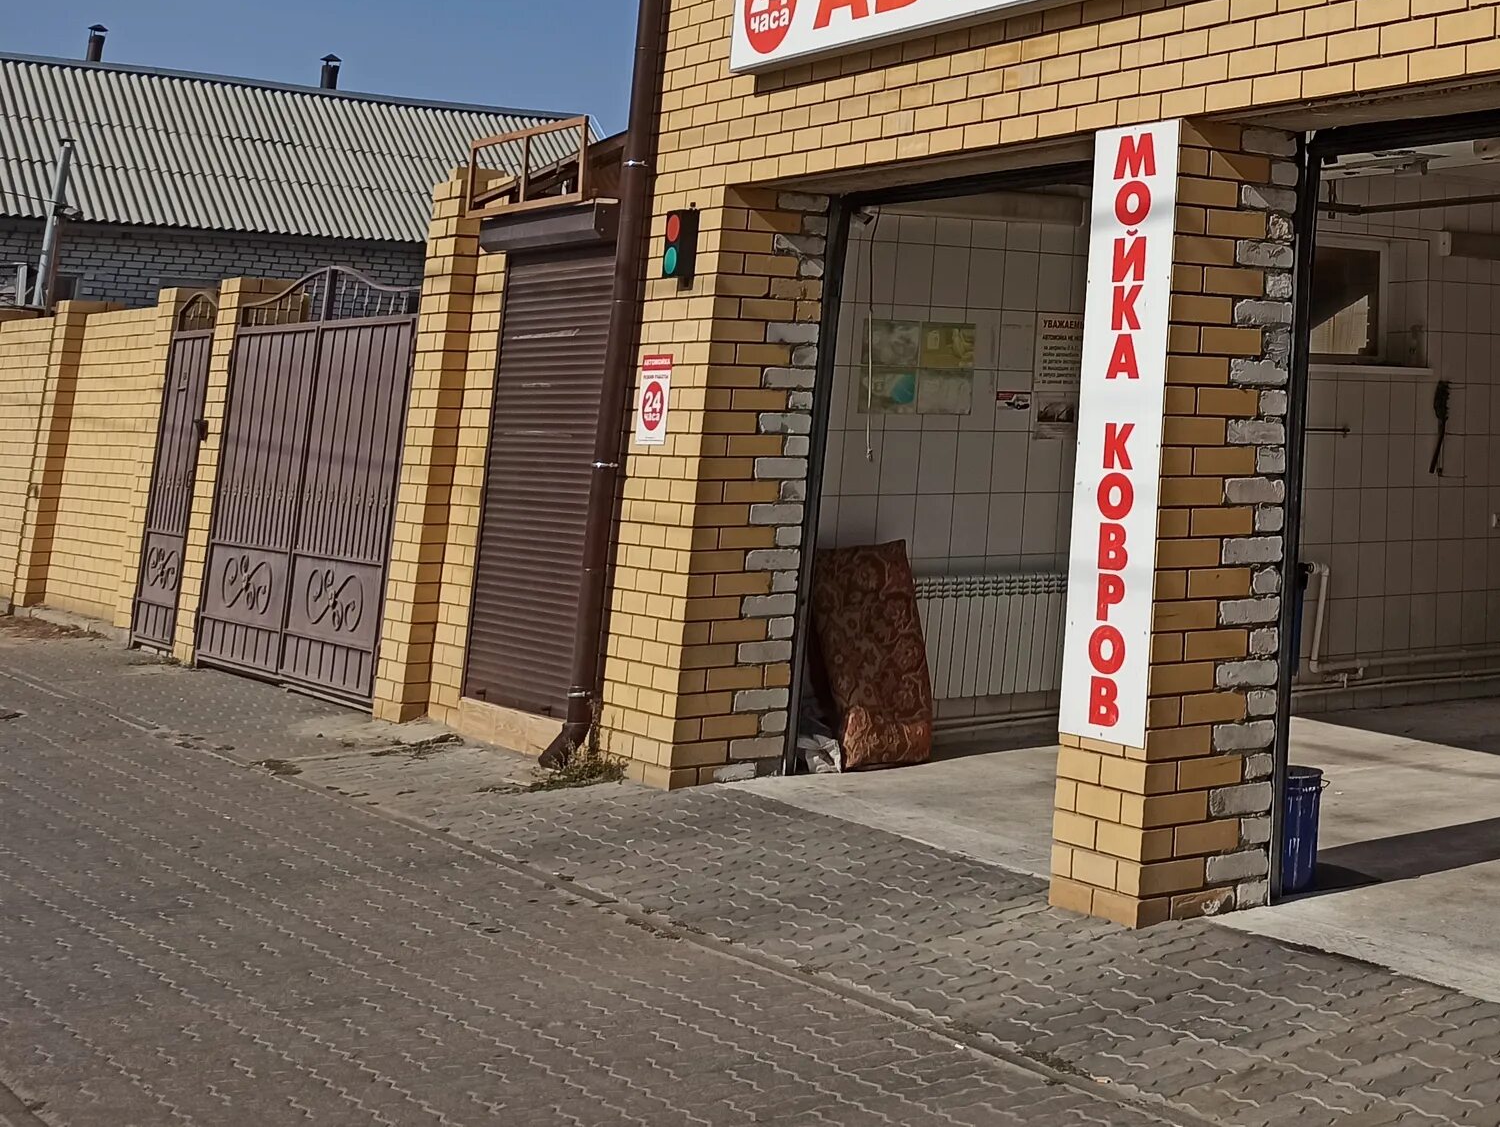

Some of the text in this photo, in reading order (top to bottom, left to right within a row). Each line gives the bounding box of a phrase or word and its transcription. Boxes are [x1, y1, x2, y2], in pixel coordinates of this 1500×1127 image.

[750, 7, 790, 34] часа
[644, 391, 661, 412] 24
[644, 412, 660, 421] часа
[1088, 132, 1156, 729] МОЙКА КОВРОВ
